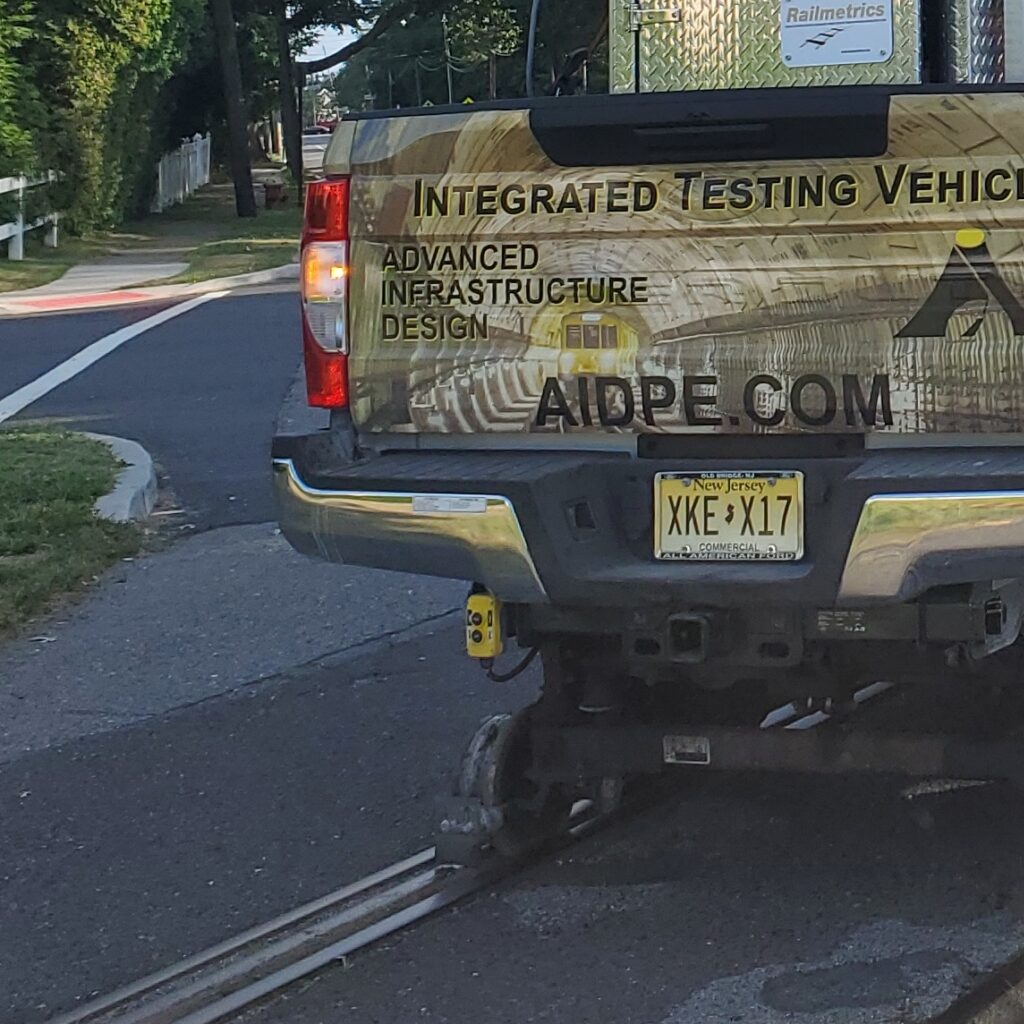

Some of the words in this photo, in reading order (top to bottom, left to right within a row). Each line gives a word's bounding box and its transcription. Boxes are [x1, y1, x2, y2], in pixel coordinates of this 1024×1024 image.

[786, 2, 885, 23] Railmetrics
[413, 178, 658, 217] INTEGRATED
[674, 171, 858, 211] TESTING
[382, 244, 539, 272] ADVANCED
[381, 276, 649, 306] INFRASTRUCTURE
[382, 312, 488, 340] DESIGN
[535, 374, 894, 427] AIDPE.COM
[693, 478, 723, 491] New
[725, 478, 766, 493] Jersey
[668, 495, 719, 535] XKE
[740, 495, 792, 535] X17
[690, 552, 756, 560] AMERICAN
[699, 543, 760, 552] COMMERCIAL
